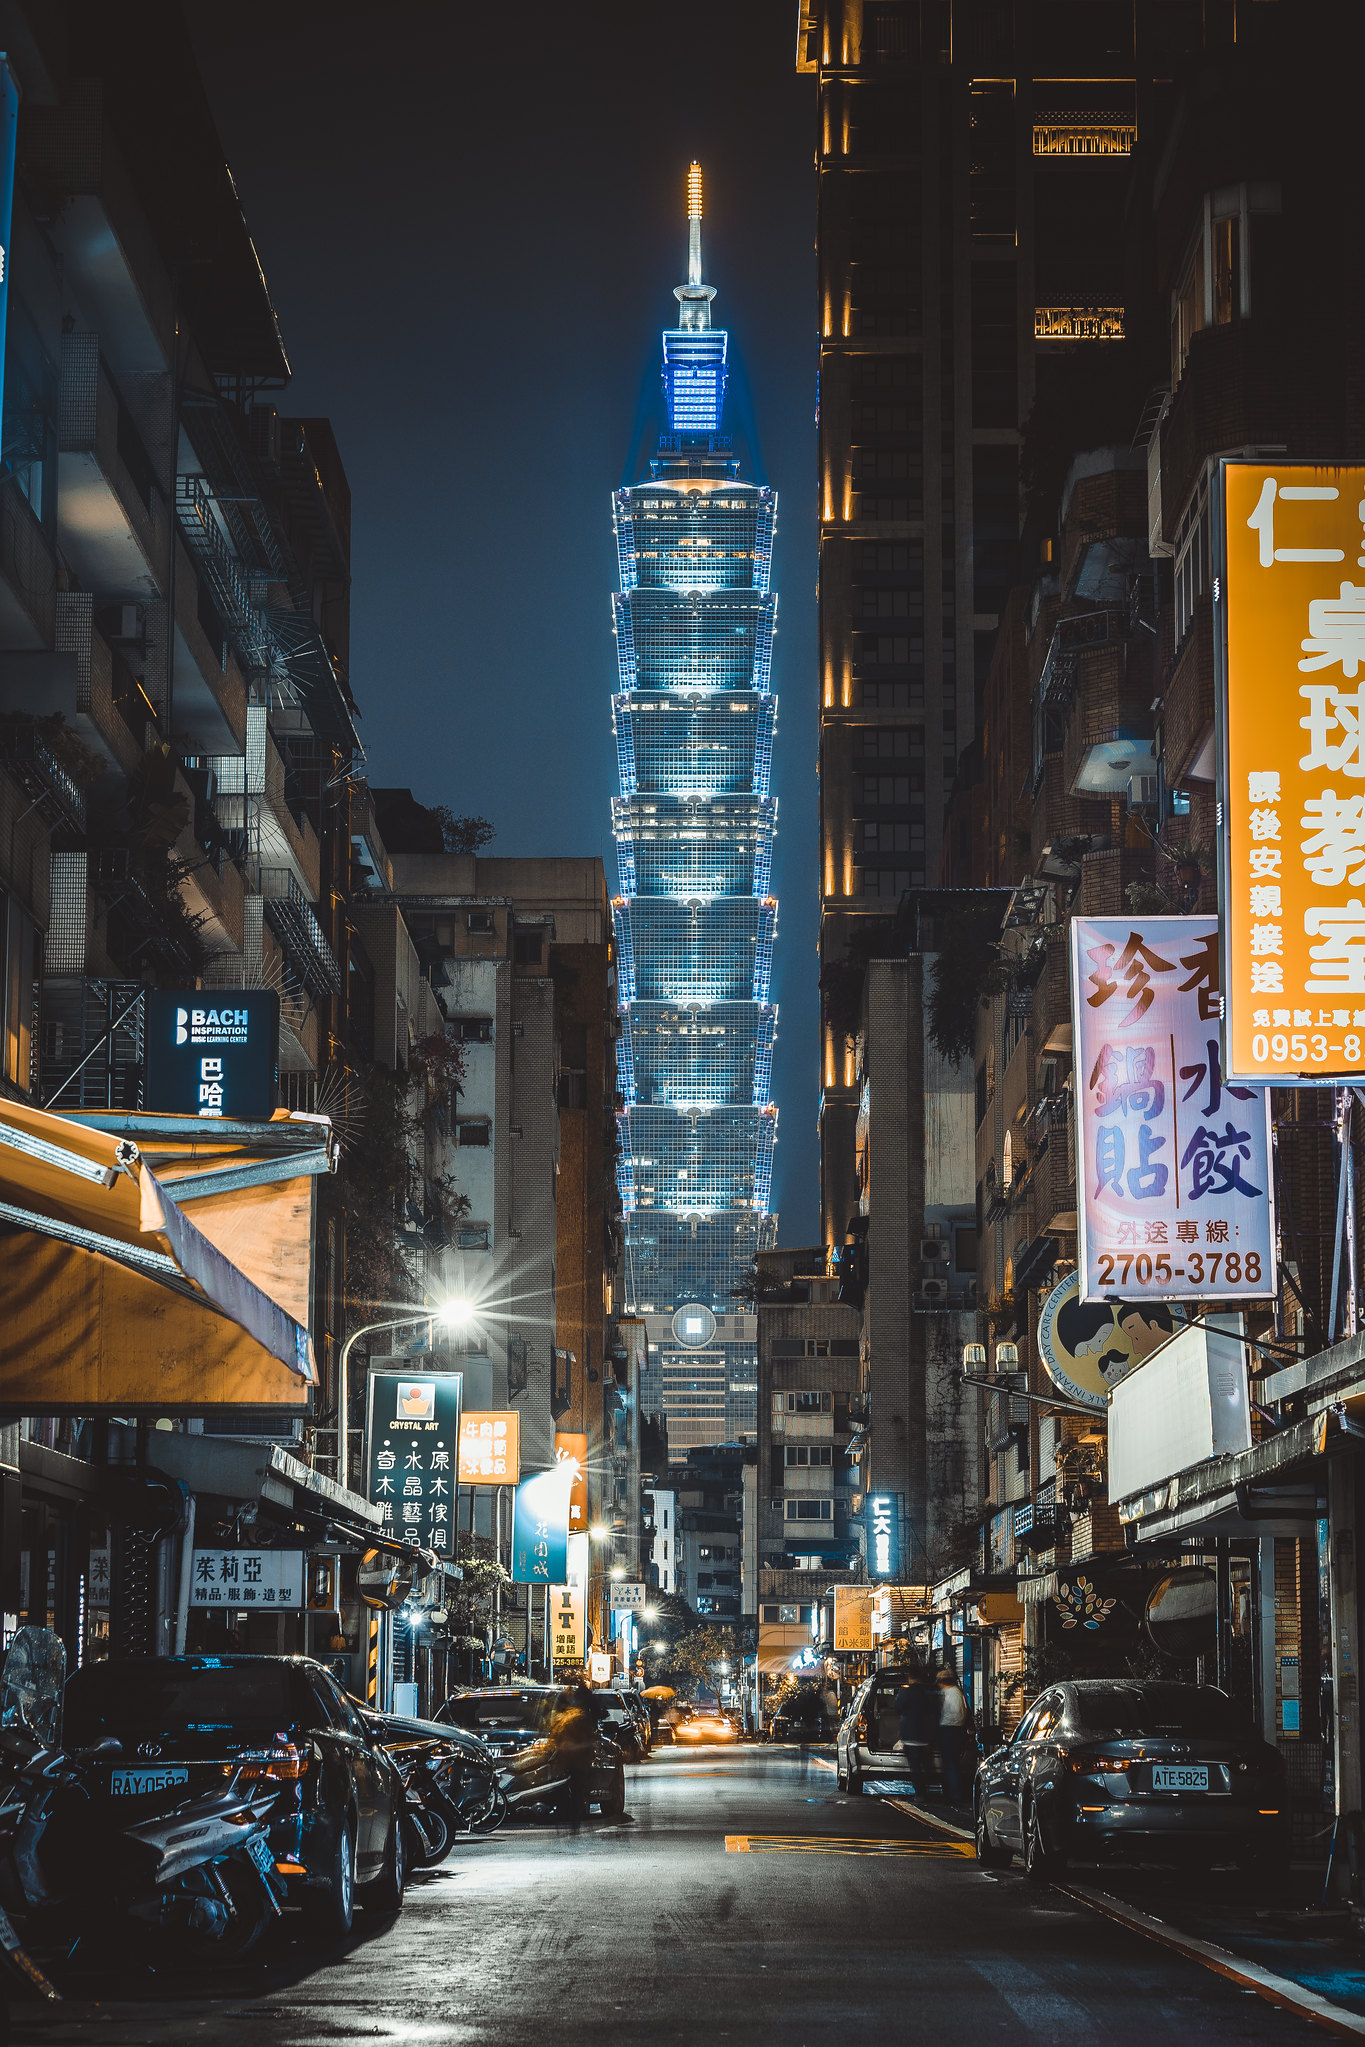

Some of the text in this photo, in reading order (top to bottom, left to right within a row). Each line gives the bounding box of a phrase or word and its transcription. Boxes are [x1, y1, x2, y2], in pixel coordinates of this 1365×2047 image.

[1247, 477, 1365, 568] 仁
[1248, 771, 1284, 994] 課後安親接送
[191, 1009, 248, 1026] BACH
[191, 1026, 248, 1035] INSPIRATION
[230, 1035, 248, 1043] CENTER
[1252, 1034, 1365, 1062] 0953-8
[1089, 1043, 1168, 1201] 鍋貼
[1180, 1039, 1264, 1201] 水餃
[1097, 1251, 1263, 1287] 2705-3788
[1049, 1275, 1078, 1310] CENTER
[1041, 1312, 1053, 1340] CARE
[1041, 1343, 1056, 1365] DAY
[1050, 1366, 1085, 1399] INFANT
[389, 1420, 440, 1431] CRYSTAL ART
[402, 1450, 424, 1547] 水晶藝品
[427, 1451, 450, 1549] 原木傢俱
[195, 1556, 262, 1583] 茱莉亞
[838, 1638, 870, 1648] 小米粥
